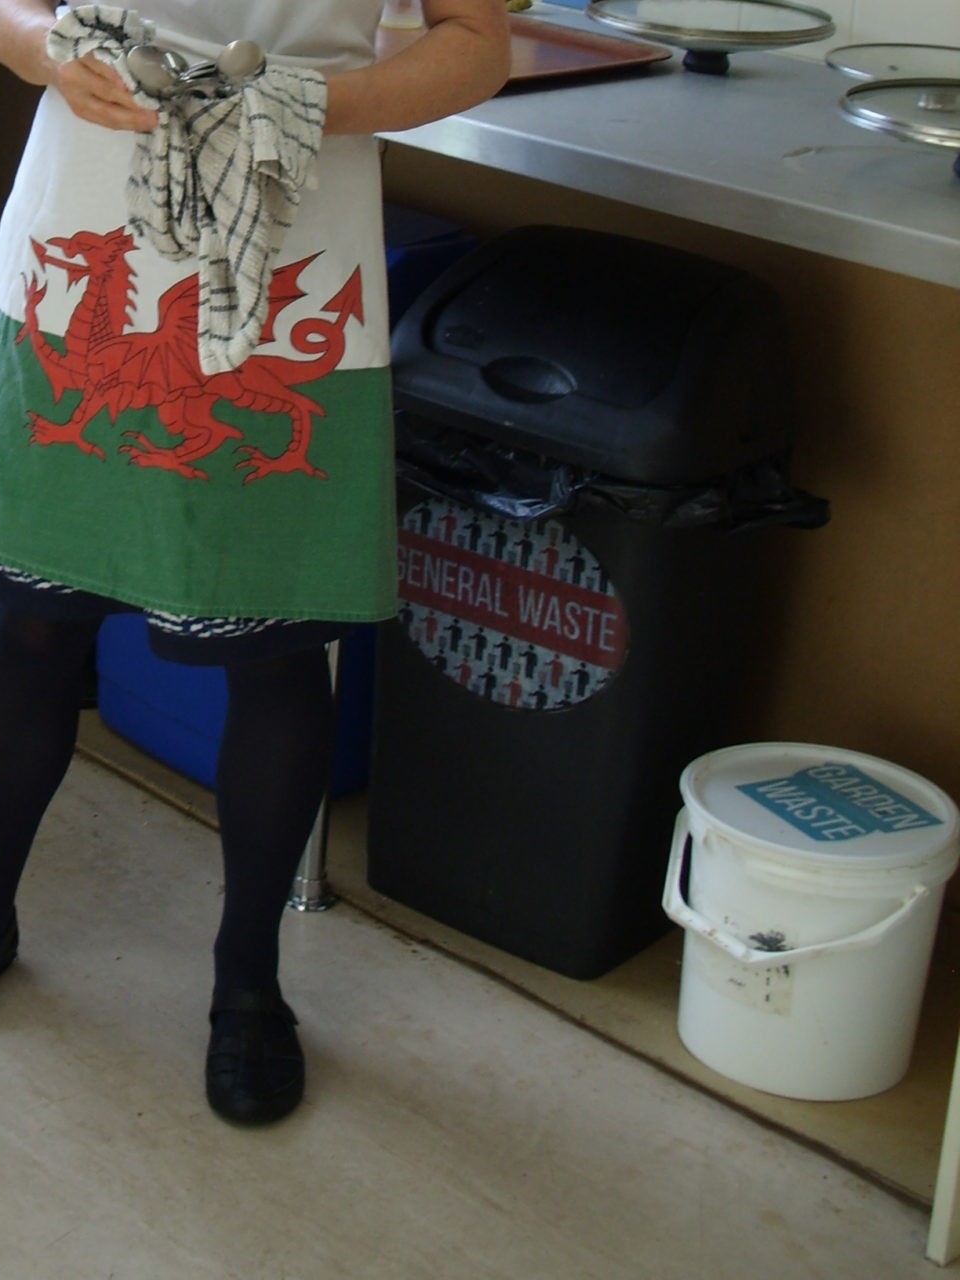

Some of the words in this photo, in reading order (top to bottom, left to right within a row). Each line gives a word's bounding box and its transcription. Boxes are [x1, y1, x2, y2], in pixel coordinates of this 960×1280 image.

[397, 544, 509, 617] GENERAL
[518, 584, 618, 651] WASTE
[756, 780, 867, 840] WASTE
[807, 765, 929, 830] GARDEN
